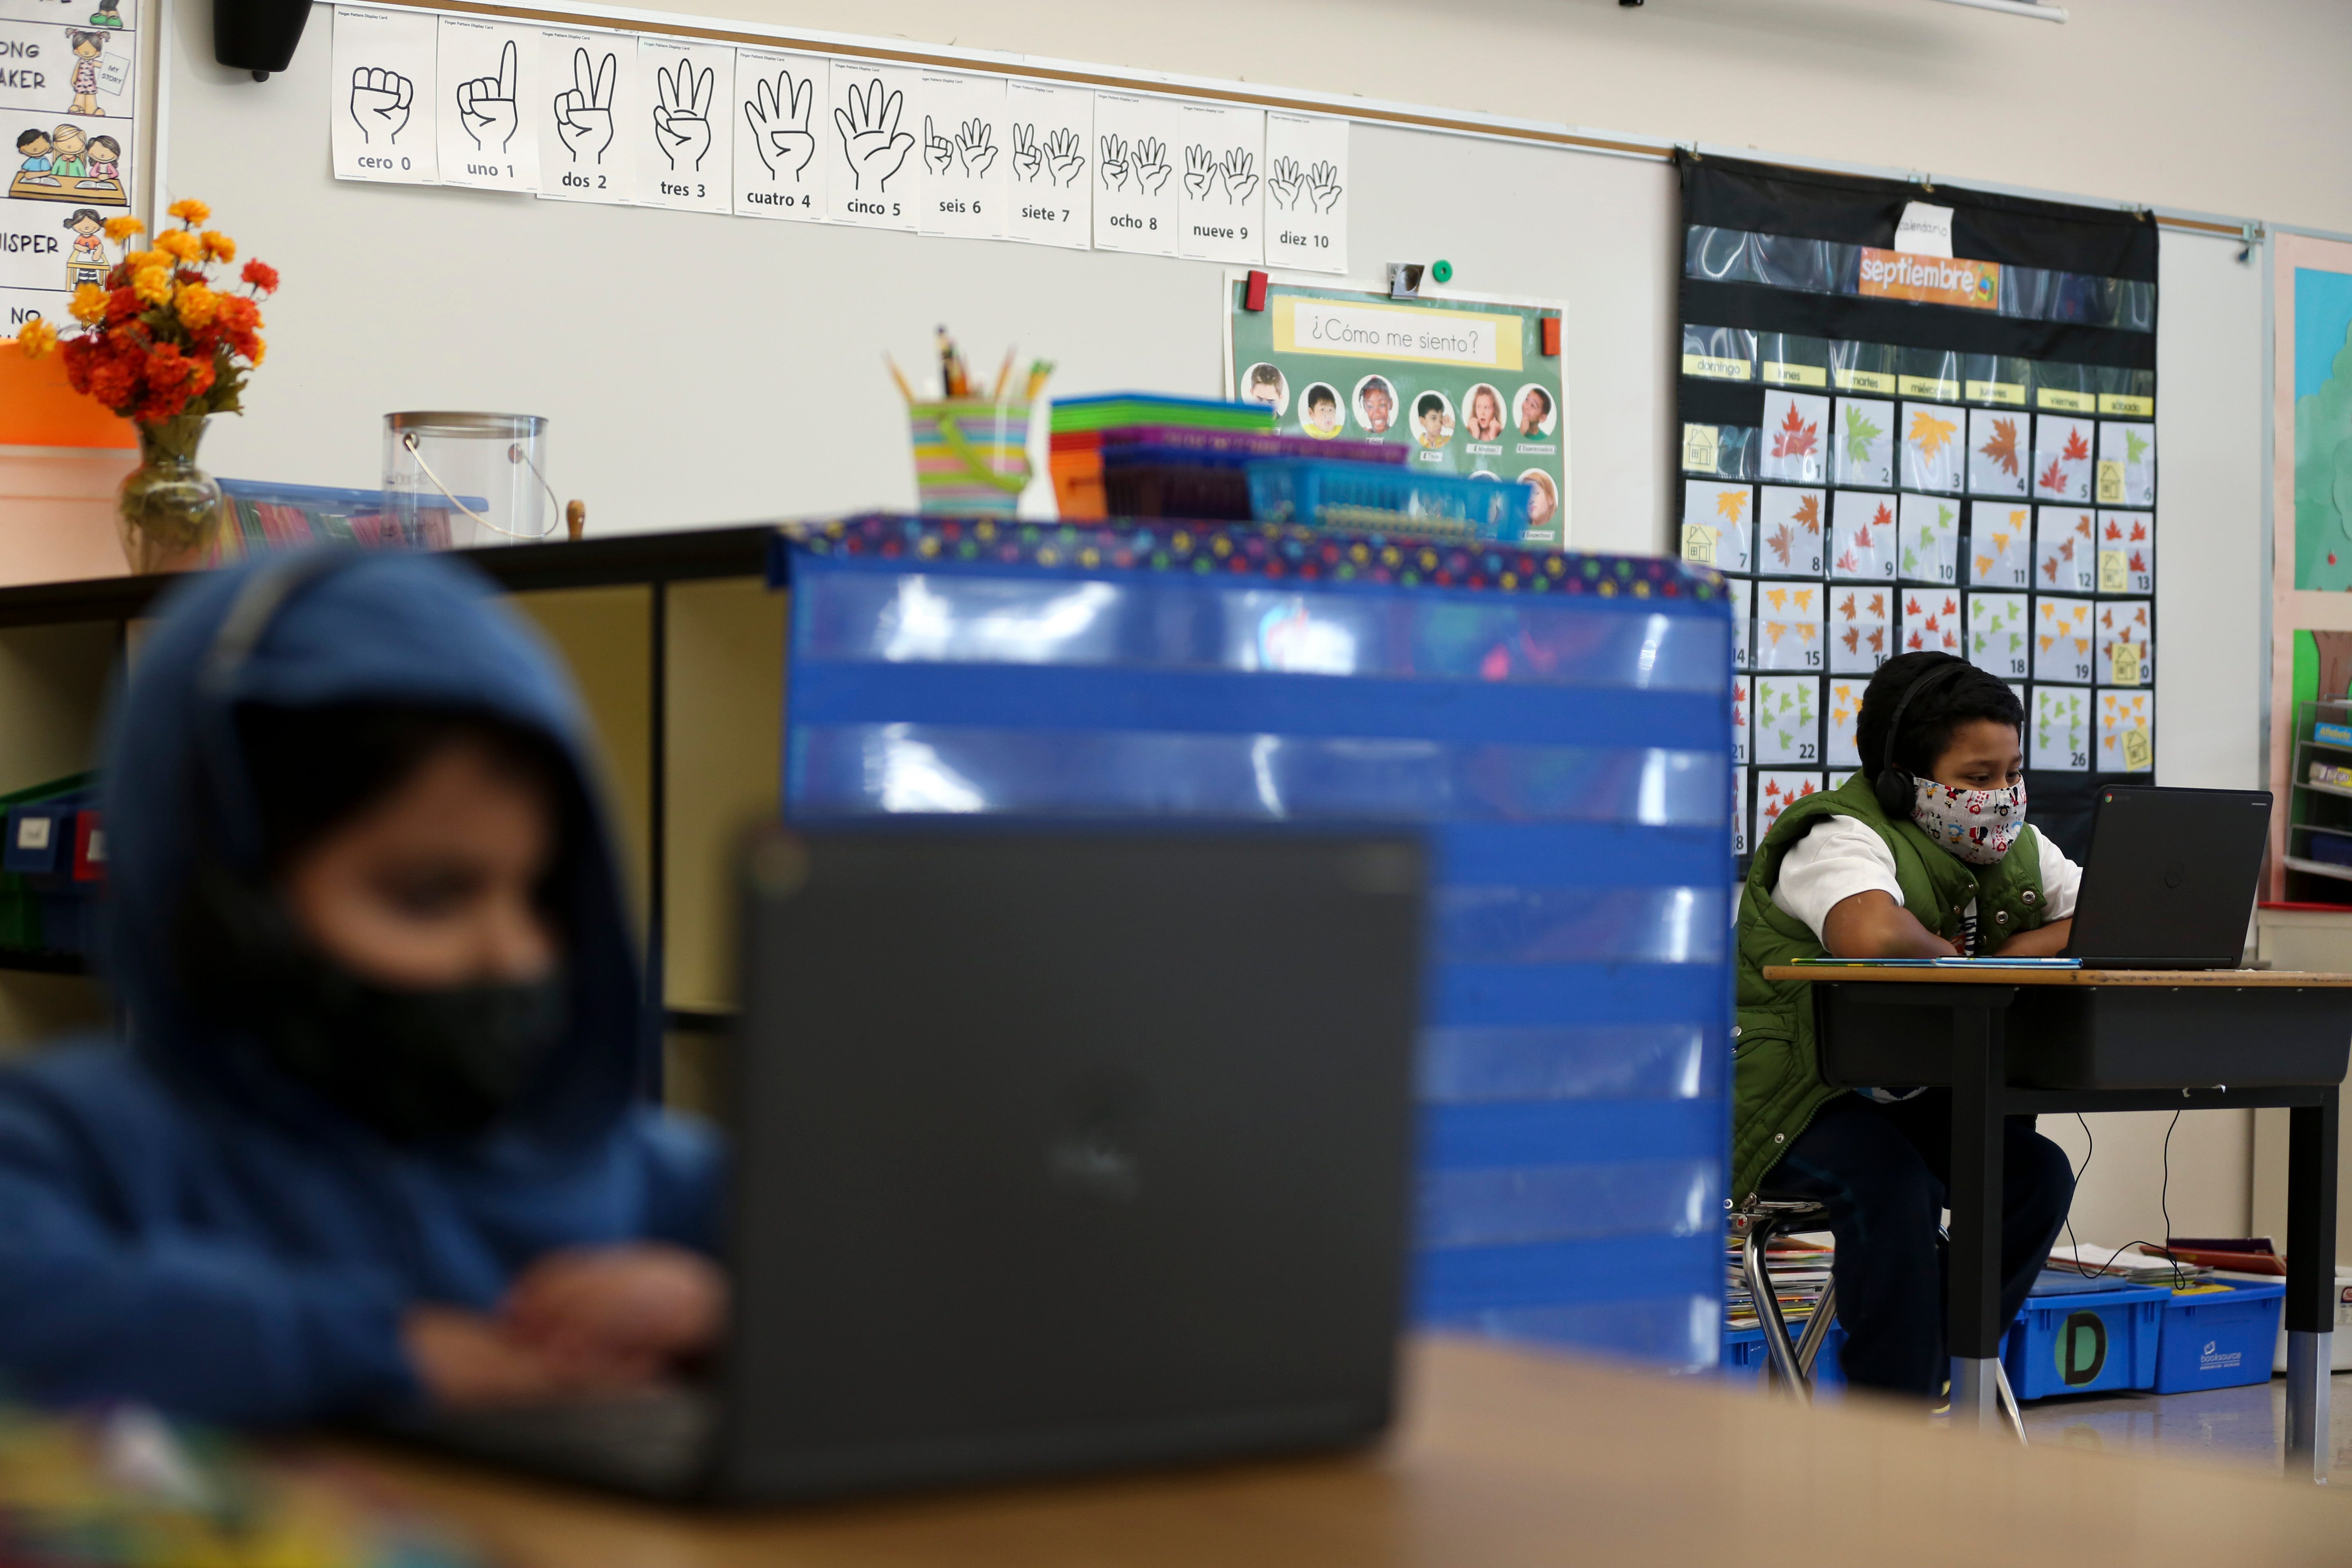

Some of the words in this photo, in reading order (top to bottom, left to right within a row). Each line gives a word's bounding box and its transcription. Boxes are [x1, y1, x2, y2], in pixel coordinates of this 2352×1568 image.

[108, 64, 119, 74] MY
[102, 72, 123, 84] STORY
[358, 157, 392, 169] cero
[401, 157, 410, 170] 0
[468, 164, 498, 176] uno
[507, 165, 514, 177] 1
[562, 172, 589, 187] dos
[598, 176, 606, 189] 2
[661, 182, 689, 196] tres
[697, 185, 705, 197] 3
[748, 193, 794, 206] cuatro
[802, 195, 810, 207] 4
[940, 199, 965, 212] seis
[973, 201, 981, 213] 6
[848, 199, 884, 214] cinco
[893, 203, 900, 216] 5
[1022, 205, 1054, 220] siete
[1062, 210, 1069, 222] 7
[1111, 214, 1142, 228] ocho
[1150, 218, 1157, 230] 8
[1898, 220, 1947, 236] calendario
[1194, 226, 1233, 238] nueve
[1241, 227, 1247, 239] 9
[1281, 231, 1306, 245] diez
[1314, 235, 1328, 248] 10
[1861, 255, 1974, 290] septiembre
[11, 306, 40, 323] NO
[1313, 316, 1379, 344] ¿Cómo
[1388, 333, 1412, 347] me
[1420, 331, 1478, 353] siento?
[1698, 360, 1741, 376] domingo
[1778, 368, 1801, 381] lunes
[1851, 374, 1878, 388] martes
[2050, 396, 2079, 408] viernes
[1815, 465, 1821, 479] 1
[1882, 468, 1889, 482] 2
[1953, 474, 1960, 488] 3
[2017, 478, 2025, 491] 4
[2081, 485, 2087, 498] 5
[2144, 486, 2152, 500] 6
[1740, 553, 1747, 567] 7
[1812, 557, 1820, 570] 8
[1885, 561, 1893, 575] 9
[1940, 565, 1953, 579] 10
[2014, 570, 2025, 583] 11
[2079, 574, 2091, 587] 12
[2138, 576, 2149, 590] 13
[1806, 651, 1820, 665] 15
[2011, 660, 2025, 674] 18
[2076, 665, 2089, 678] 19
[2140, 665, 2149, 678] 0
[1800, 744, 1815, 758] 22
[2072, 753, 2085, 766] 26
[1734, 835, 1744, 850] 8
[2065, 1313, 2106, 1385] D
